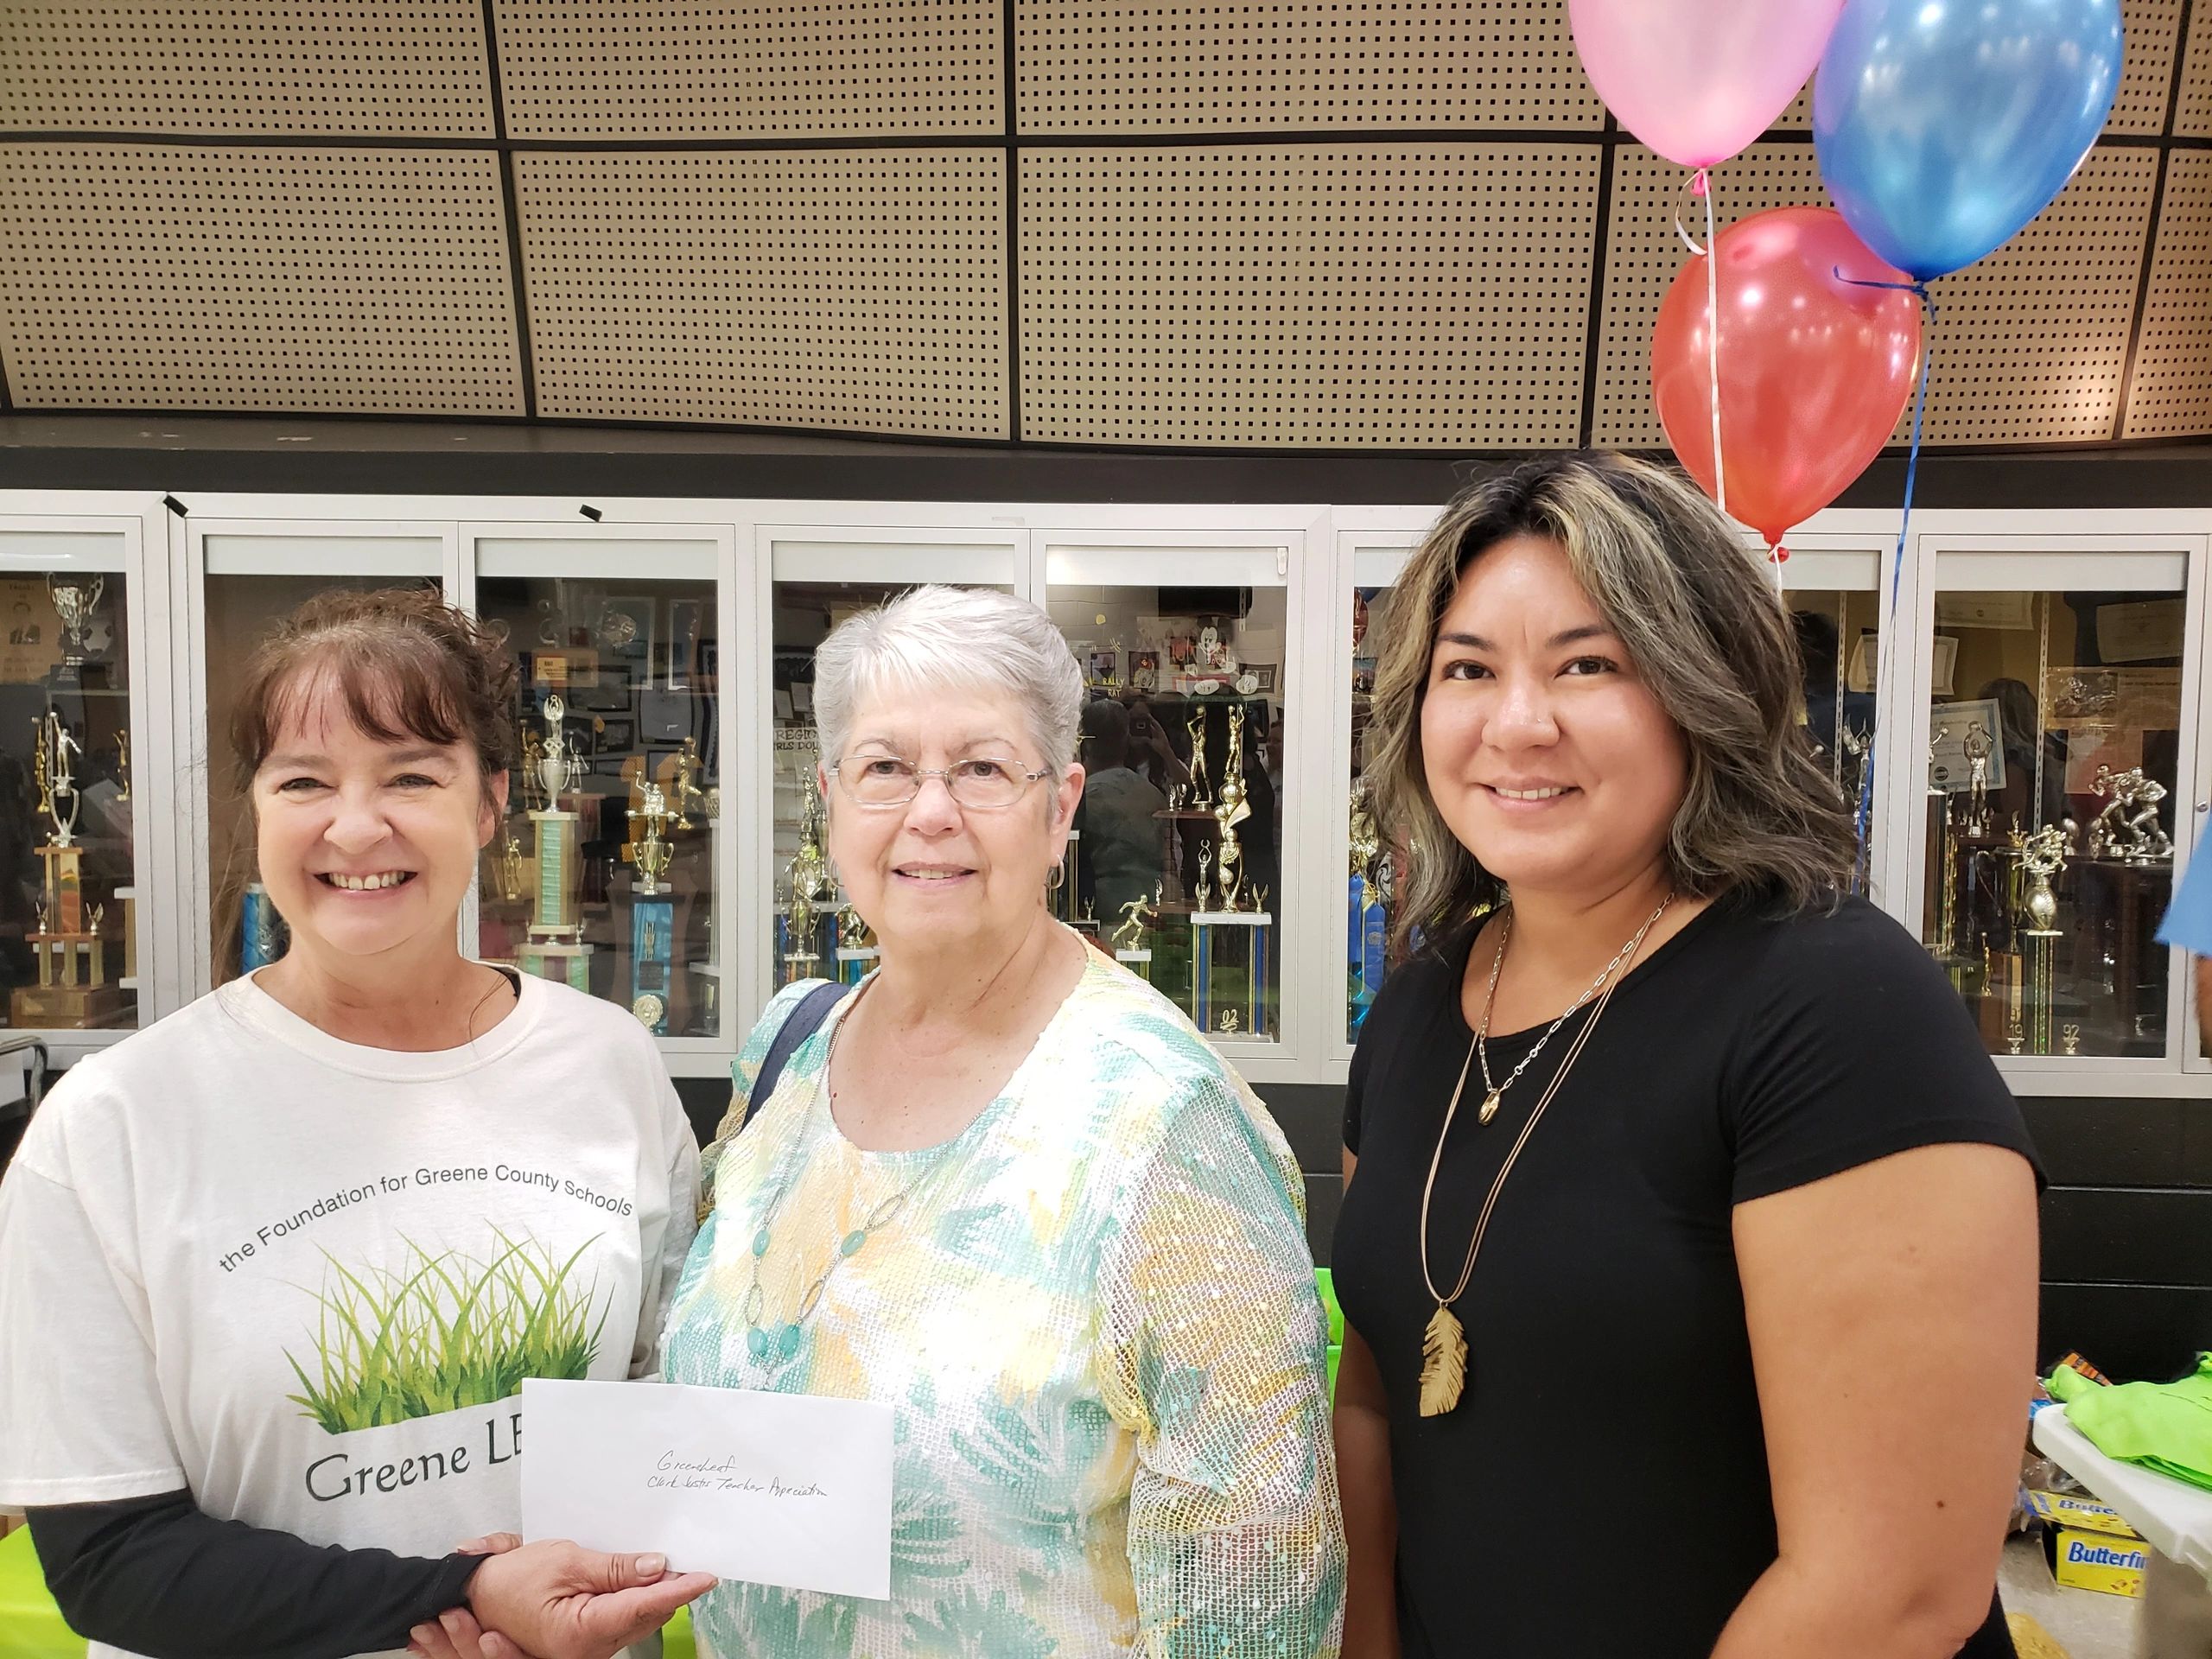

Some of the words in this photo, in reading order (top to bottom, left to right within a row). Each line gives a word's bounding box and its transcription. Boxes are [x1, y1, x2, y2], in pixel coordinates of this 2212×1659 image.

[1108, 689, 1122, 697] RAT
[219, 1240, 256, 1273] the
[257, 1181, 377, 1246] Foundation
[379, 1169, 409, 1194] for
[415, 1166, 488, 1185] Greene
[494, 1164, 560, 1192] County
[563, 1179, 634, 1217] Schools
[305, 1446, 471, 1502] Greene
[2059, 1499, 2119, 1516] Butte
